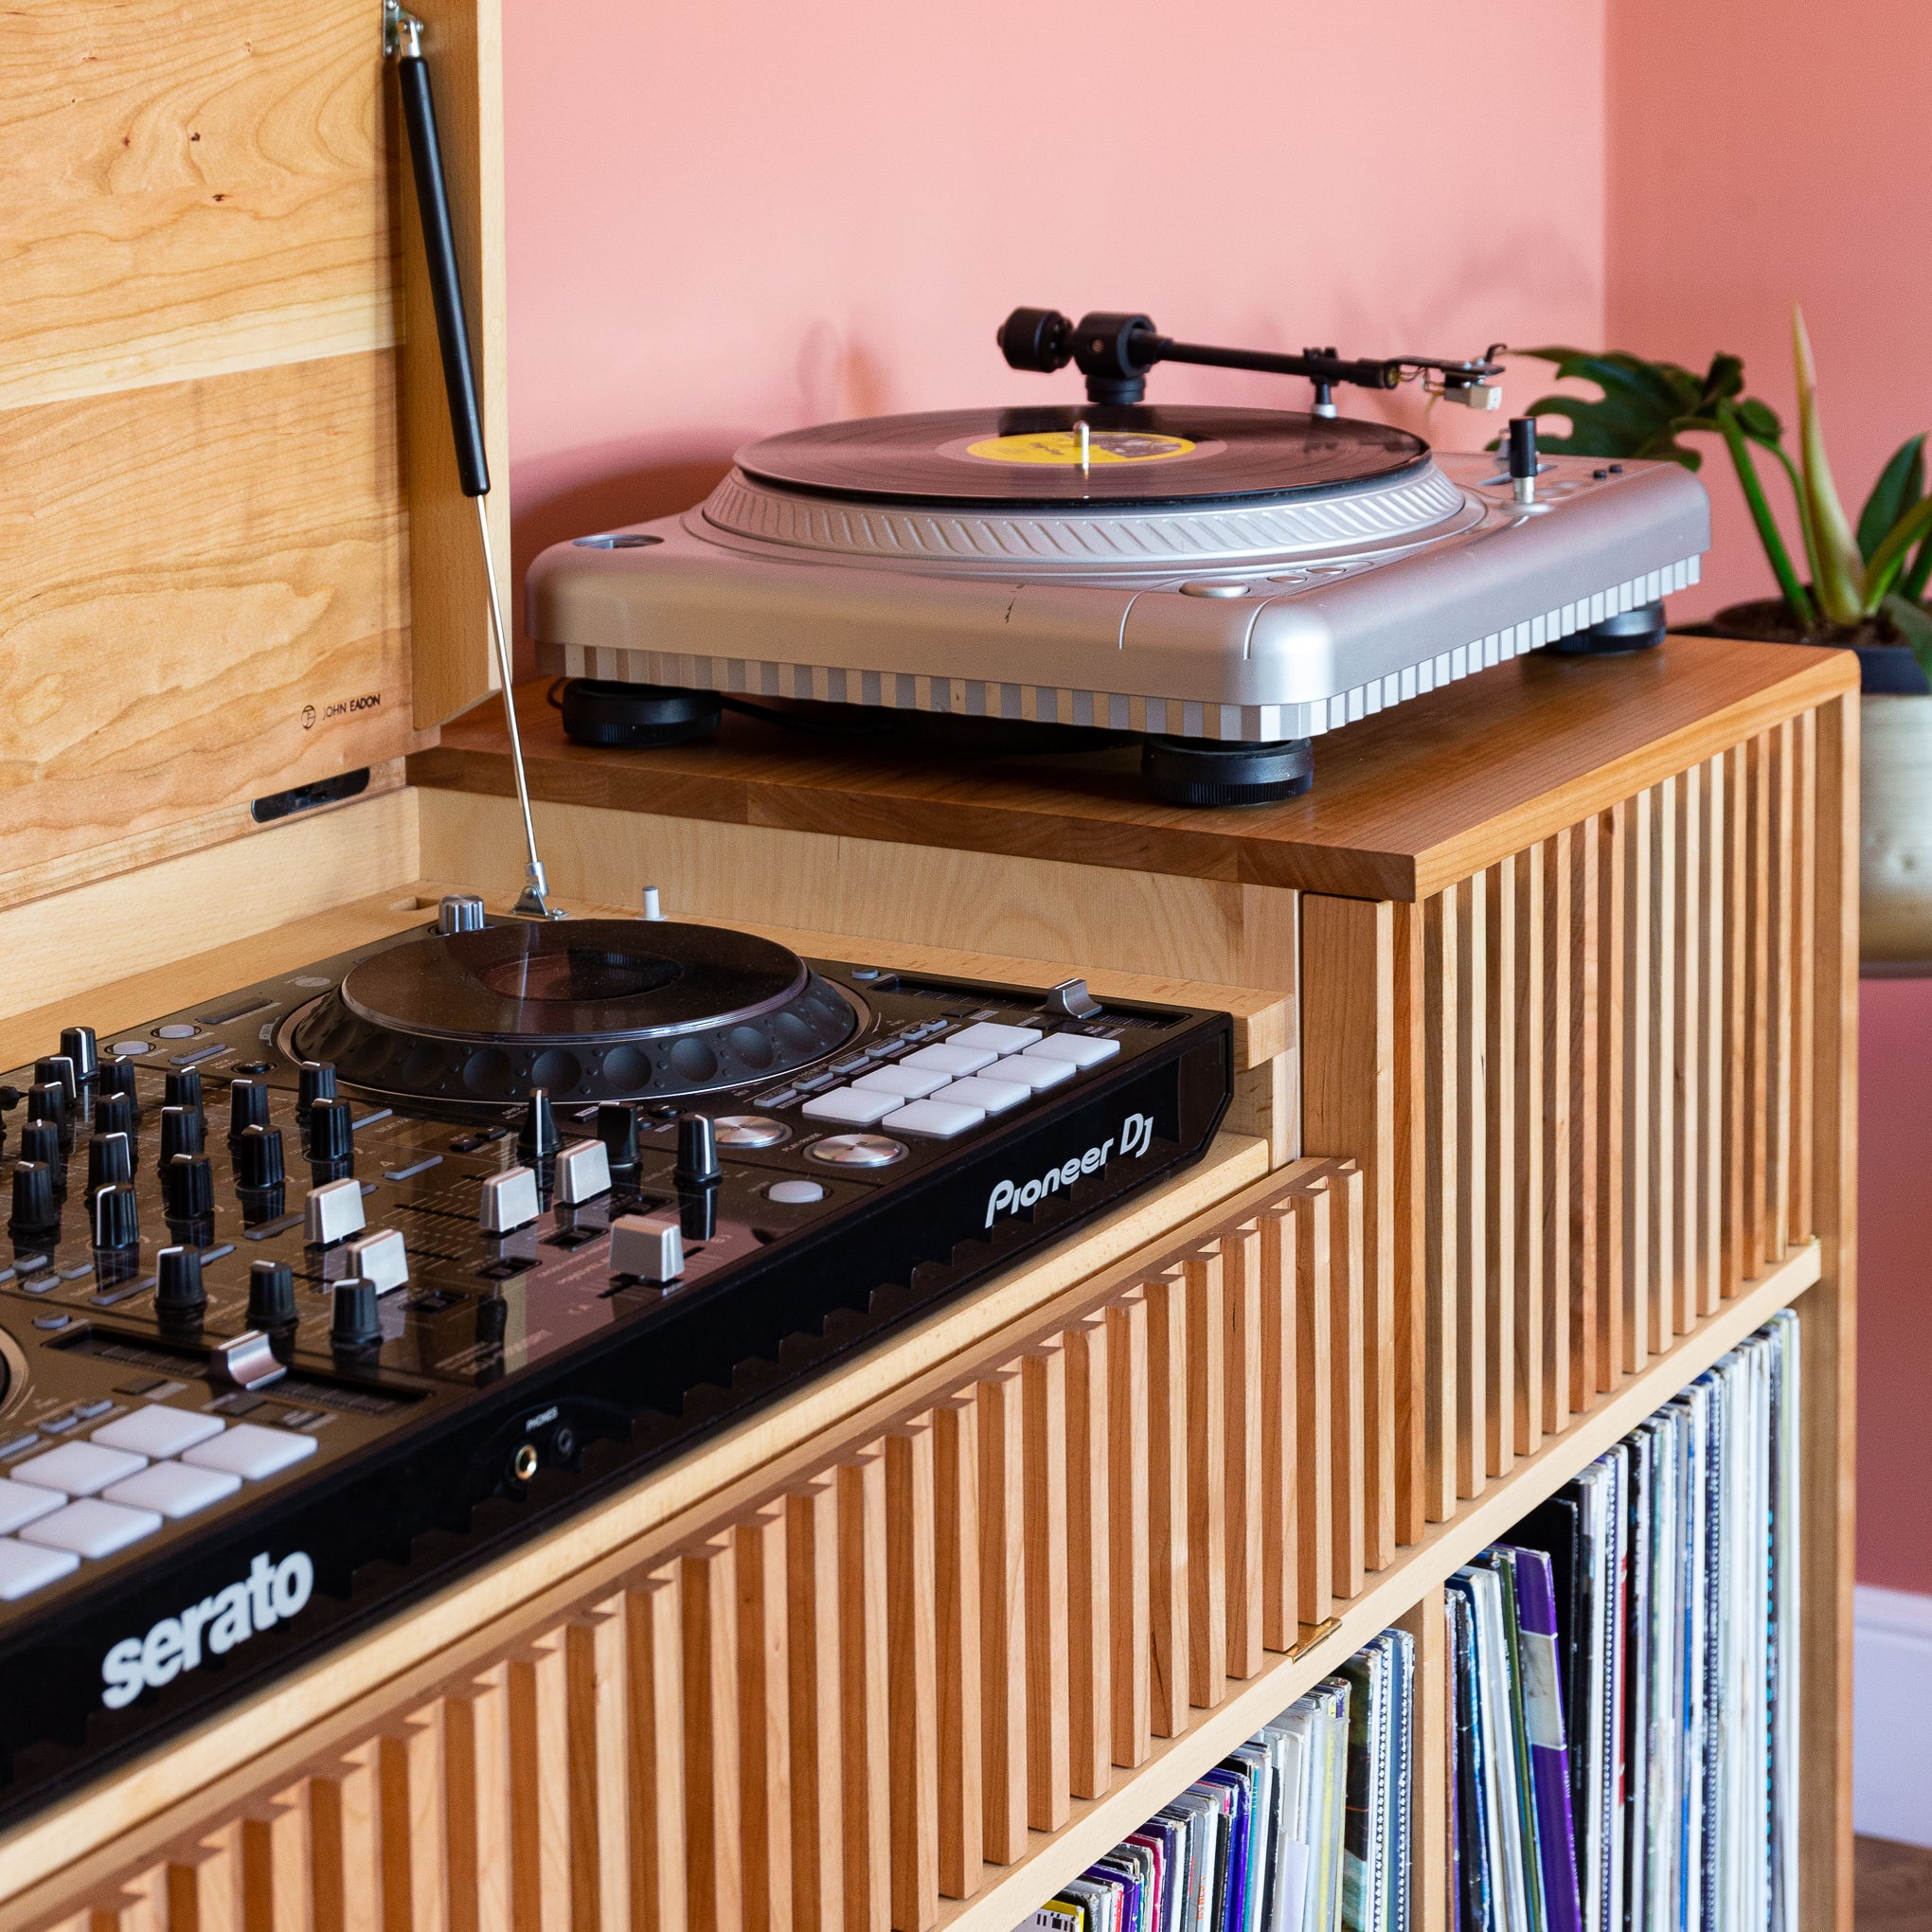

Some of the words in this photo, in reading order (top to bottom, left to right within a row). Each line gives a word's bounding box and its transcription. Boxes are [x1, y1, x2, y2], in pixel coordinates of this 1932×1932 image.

[322, 702, 347, 721] JOHN
[349, 692, 381, 712] EADON
[984, 1137, 1115, 1229] Pioneer
[101, 1550, 314, 1709] serato
